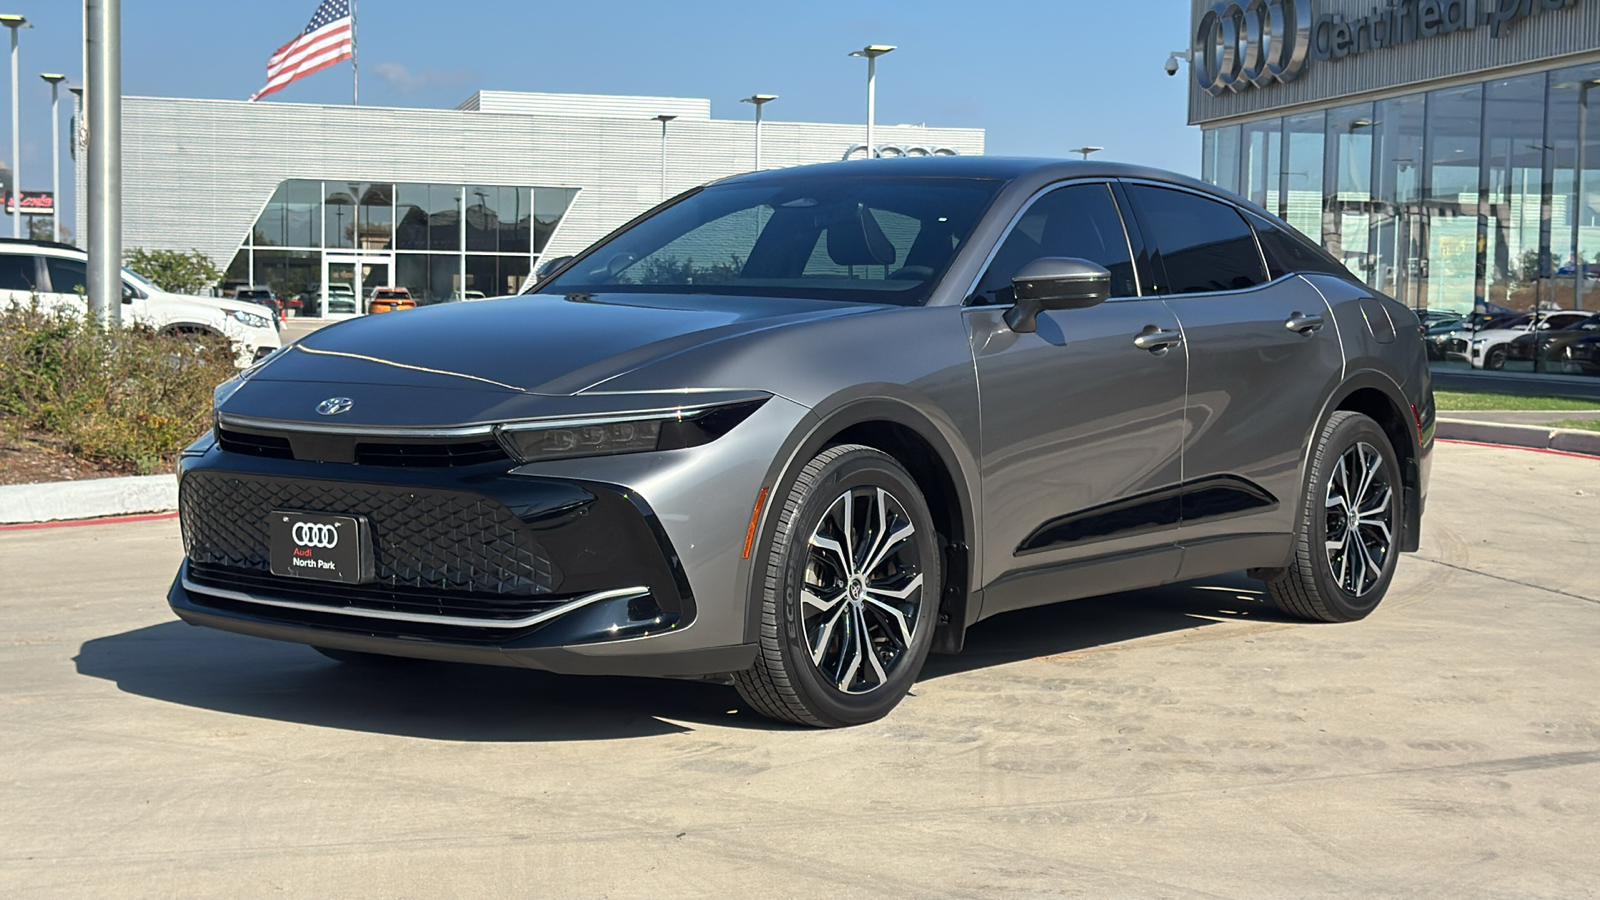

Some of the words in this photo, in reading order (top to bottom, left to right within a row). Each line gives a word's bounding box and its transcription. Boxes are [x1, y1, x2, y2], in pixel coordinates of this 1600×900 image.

[1313, 0, 1475, 61] Certified
[293, 548, 312, 556] Audi
[293, 557, 316, 567] North
[318, 560, 335, 570] Park
